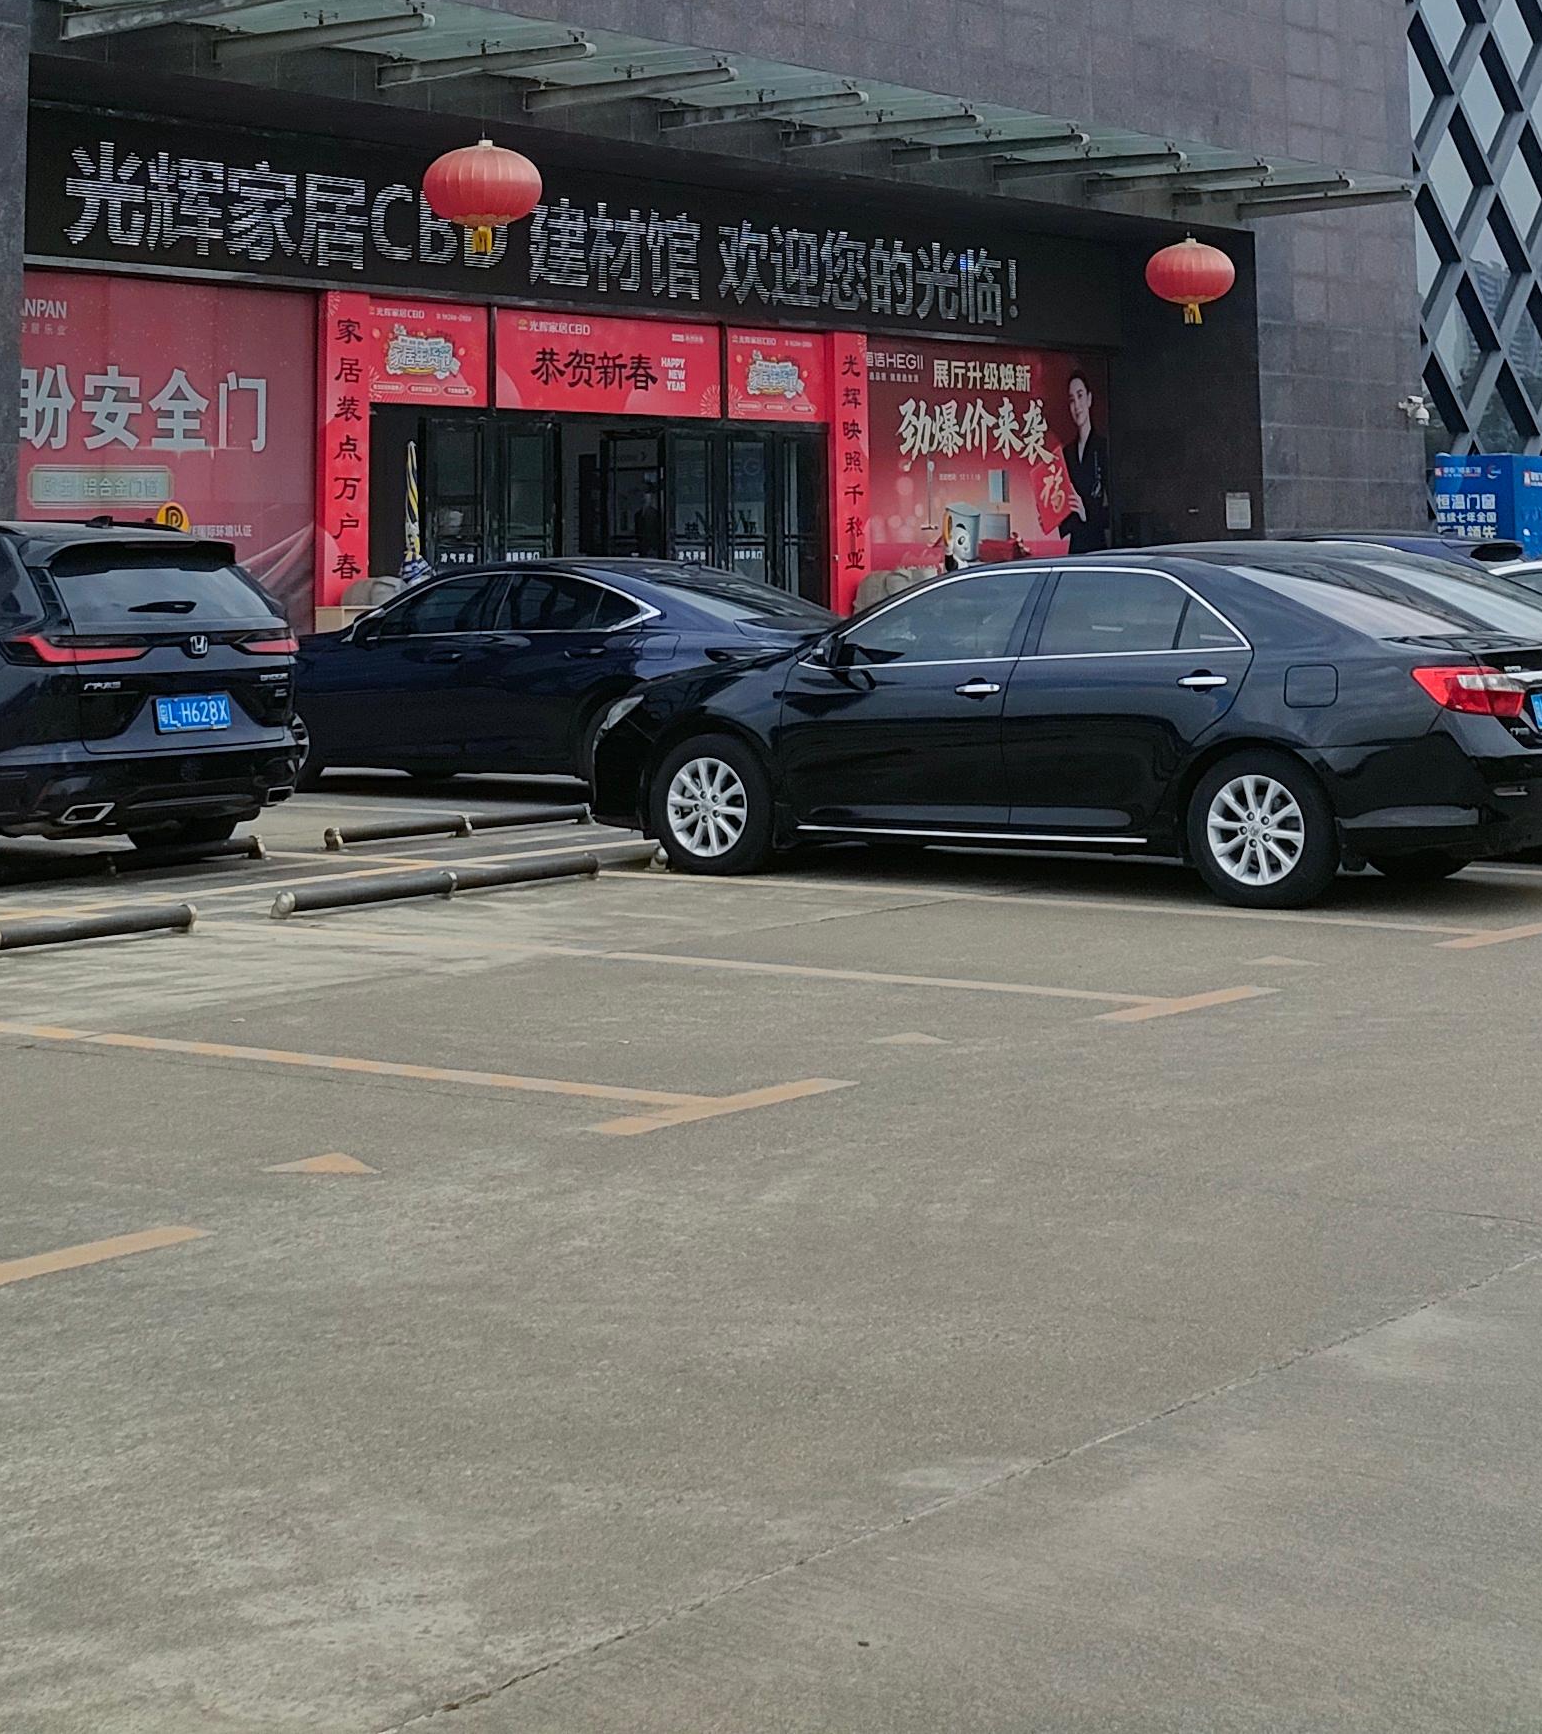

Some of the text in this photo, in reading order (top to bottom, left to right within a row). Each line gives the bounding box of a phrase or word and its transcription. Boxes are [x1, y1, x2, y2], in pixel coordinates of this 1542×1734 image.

[527, 197, 701, 300] 建材馆
[19, 298, 67, 319] NPAN
[530, 347, 658, 391] 恭贺新春
[661, 357, 685, 369] HAPPY
[668, 369, 685, 380] NEW
[933, 359, 1031, 392] 展厅升级焕新
[666, 381, 686, 392] YEAR
[19, 364, 267, 453] 盼安全门
[896, 397, 1061, 466] 劲爆价来袭
[333, 317, 364, 580] 家居装点万户春
[1436, 493, 1496, 509] 恒温门窗
